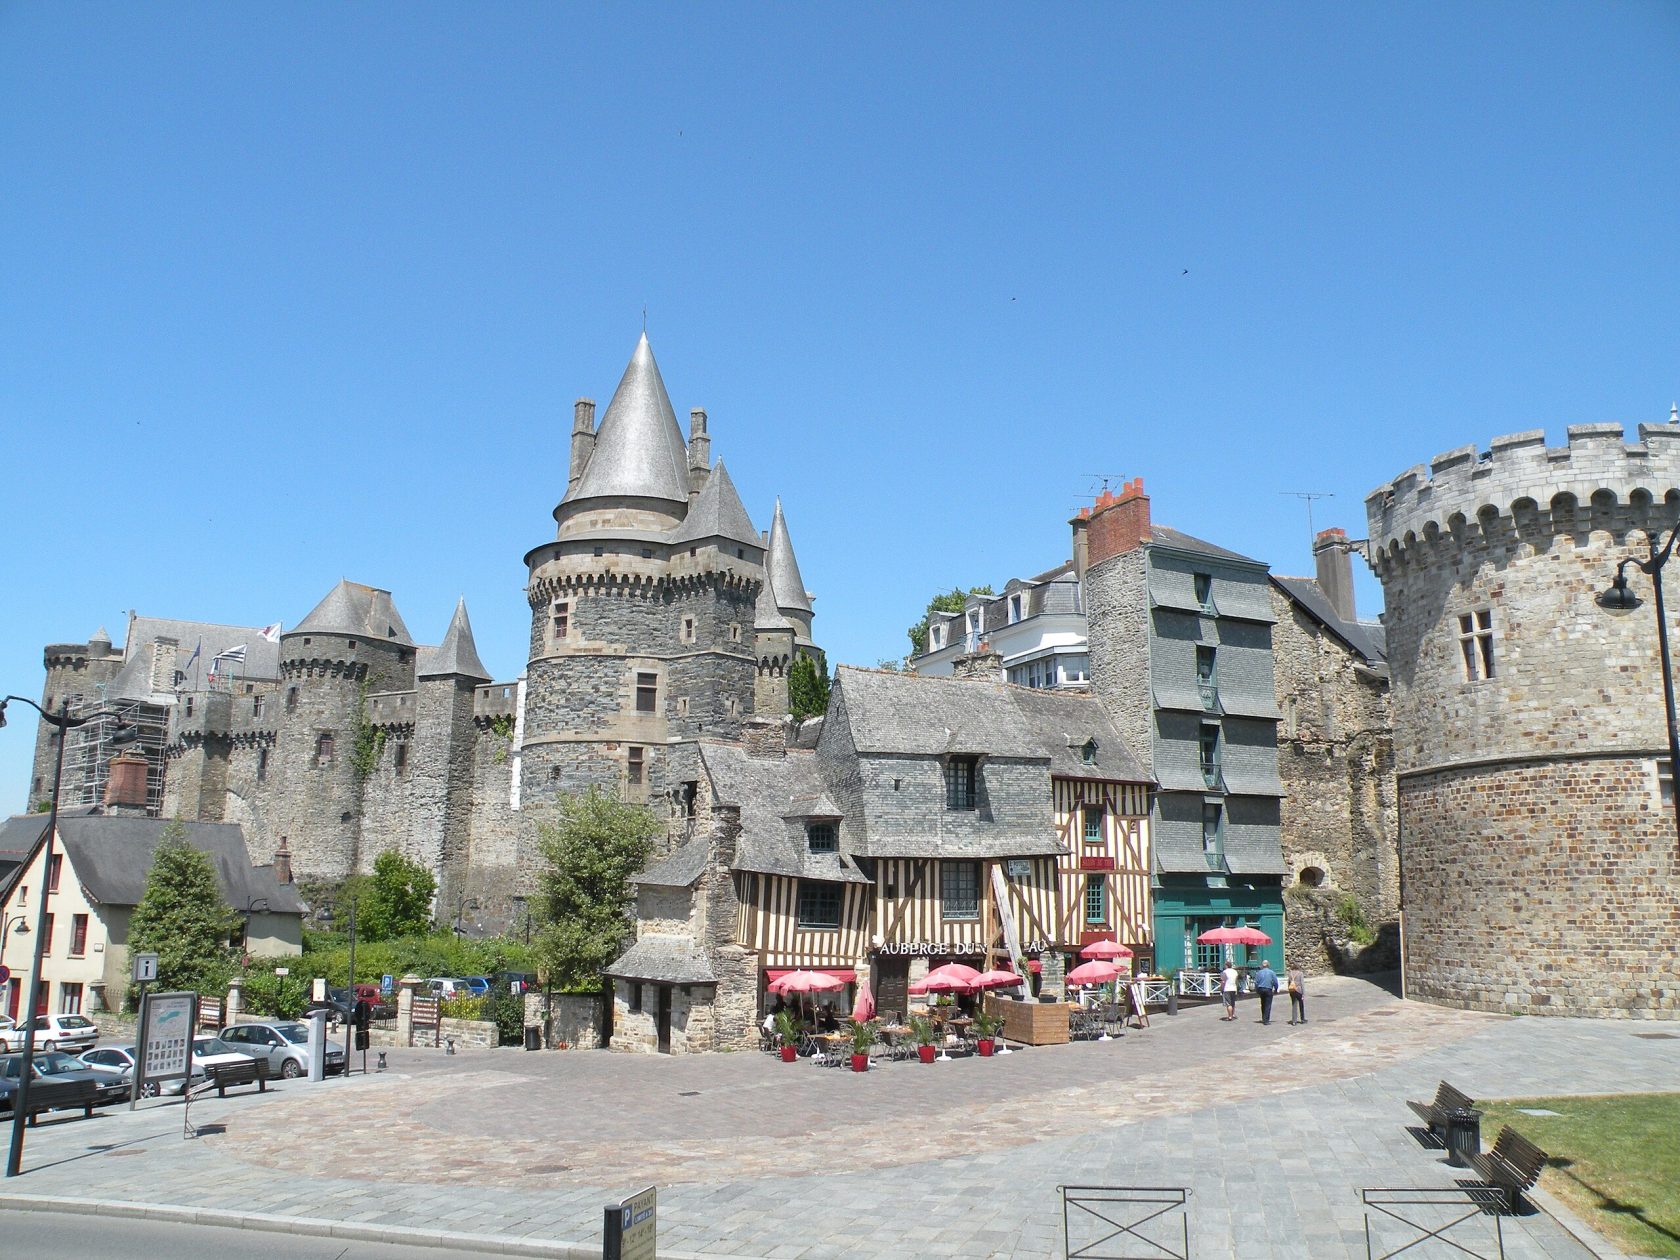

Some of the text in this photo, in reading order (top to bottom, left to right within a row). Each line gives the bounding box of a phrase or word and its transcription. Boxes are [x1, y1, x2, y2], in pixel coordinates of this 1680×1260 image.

[880, 942, 948, 954] AUBERGE
[956, 942, 974, 954] DU
[634, 1194, 654, 1212] PAYANT
[624, 1208, 631, 1227] P
